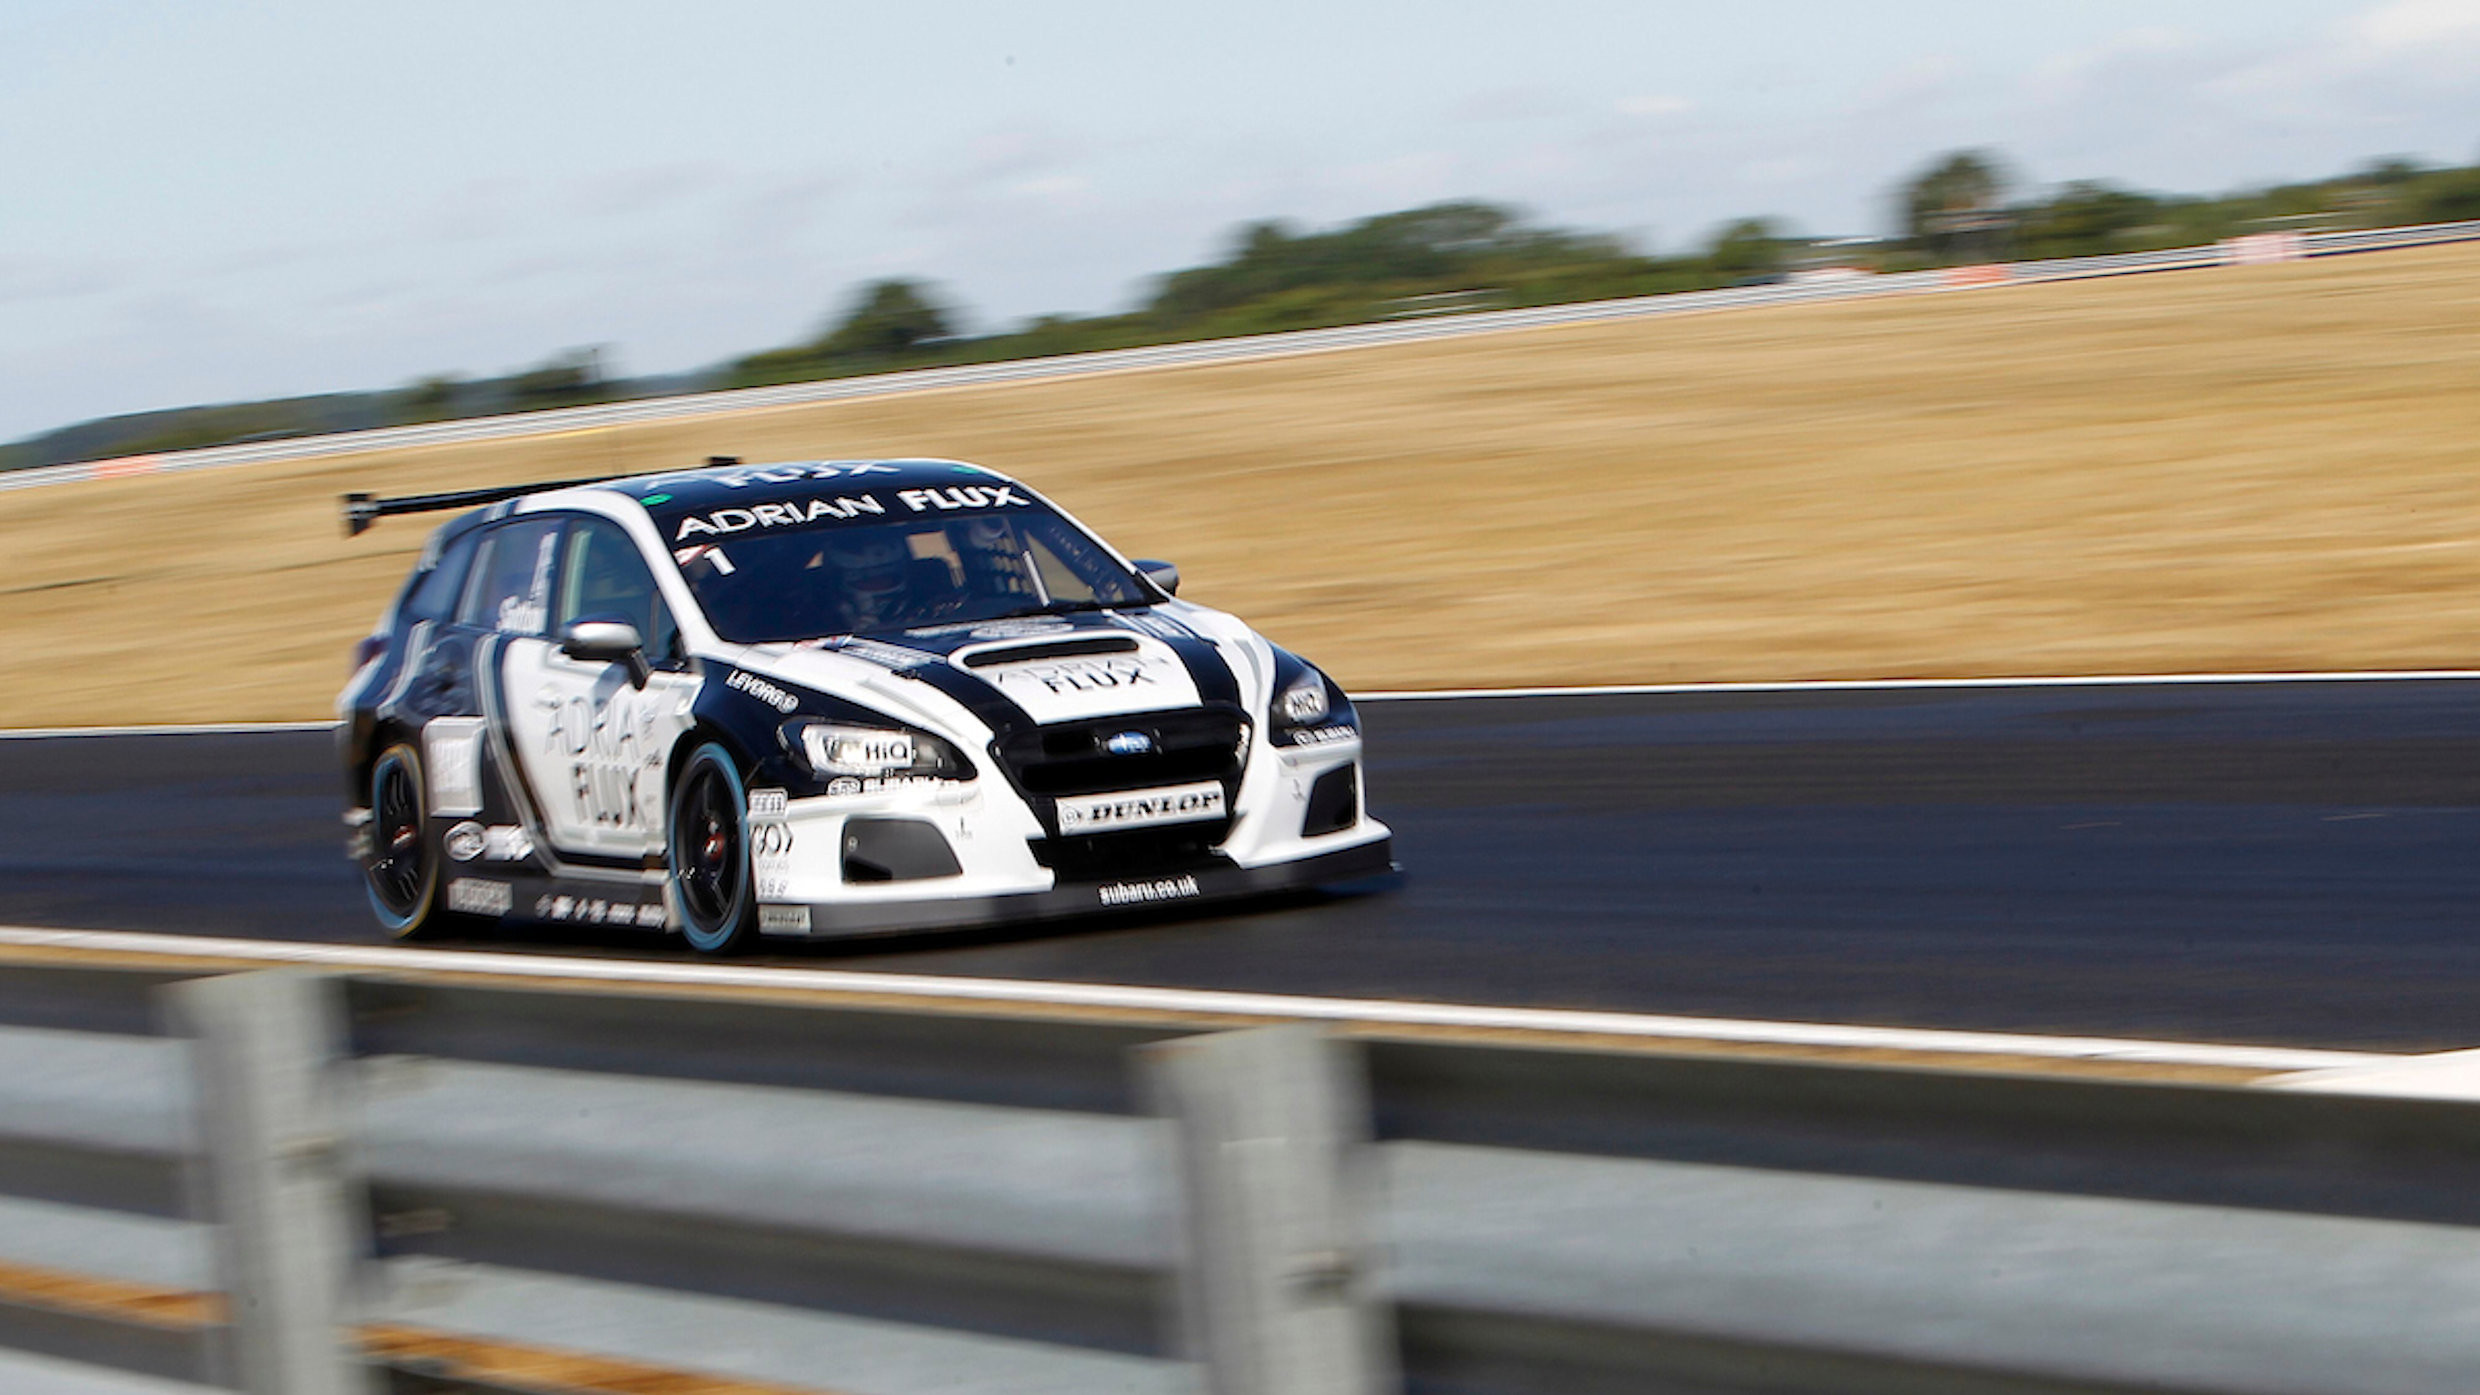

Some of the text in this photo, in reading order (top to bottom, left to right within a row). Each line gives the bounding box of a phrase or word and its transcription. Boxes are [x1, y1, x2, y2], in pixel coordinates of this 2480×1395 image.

[675, 486, 1031, 542] ADRIAN FLUX
[703, 546, 737, 576] 1
[1041, 667, 1159, 694] FLUX
[865, 741, 908, 760] HiQ
[569, 762, 648, 828] FLUX
[1090, 791, 1220, 821] DUNLOP
[1099, 874, 1200, 905] subaru.co.uk
